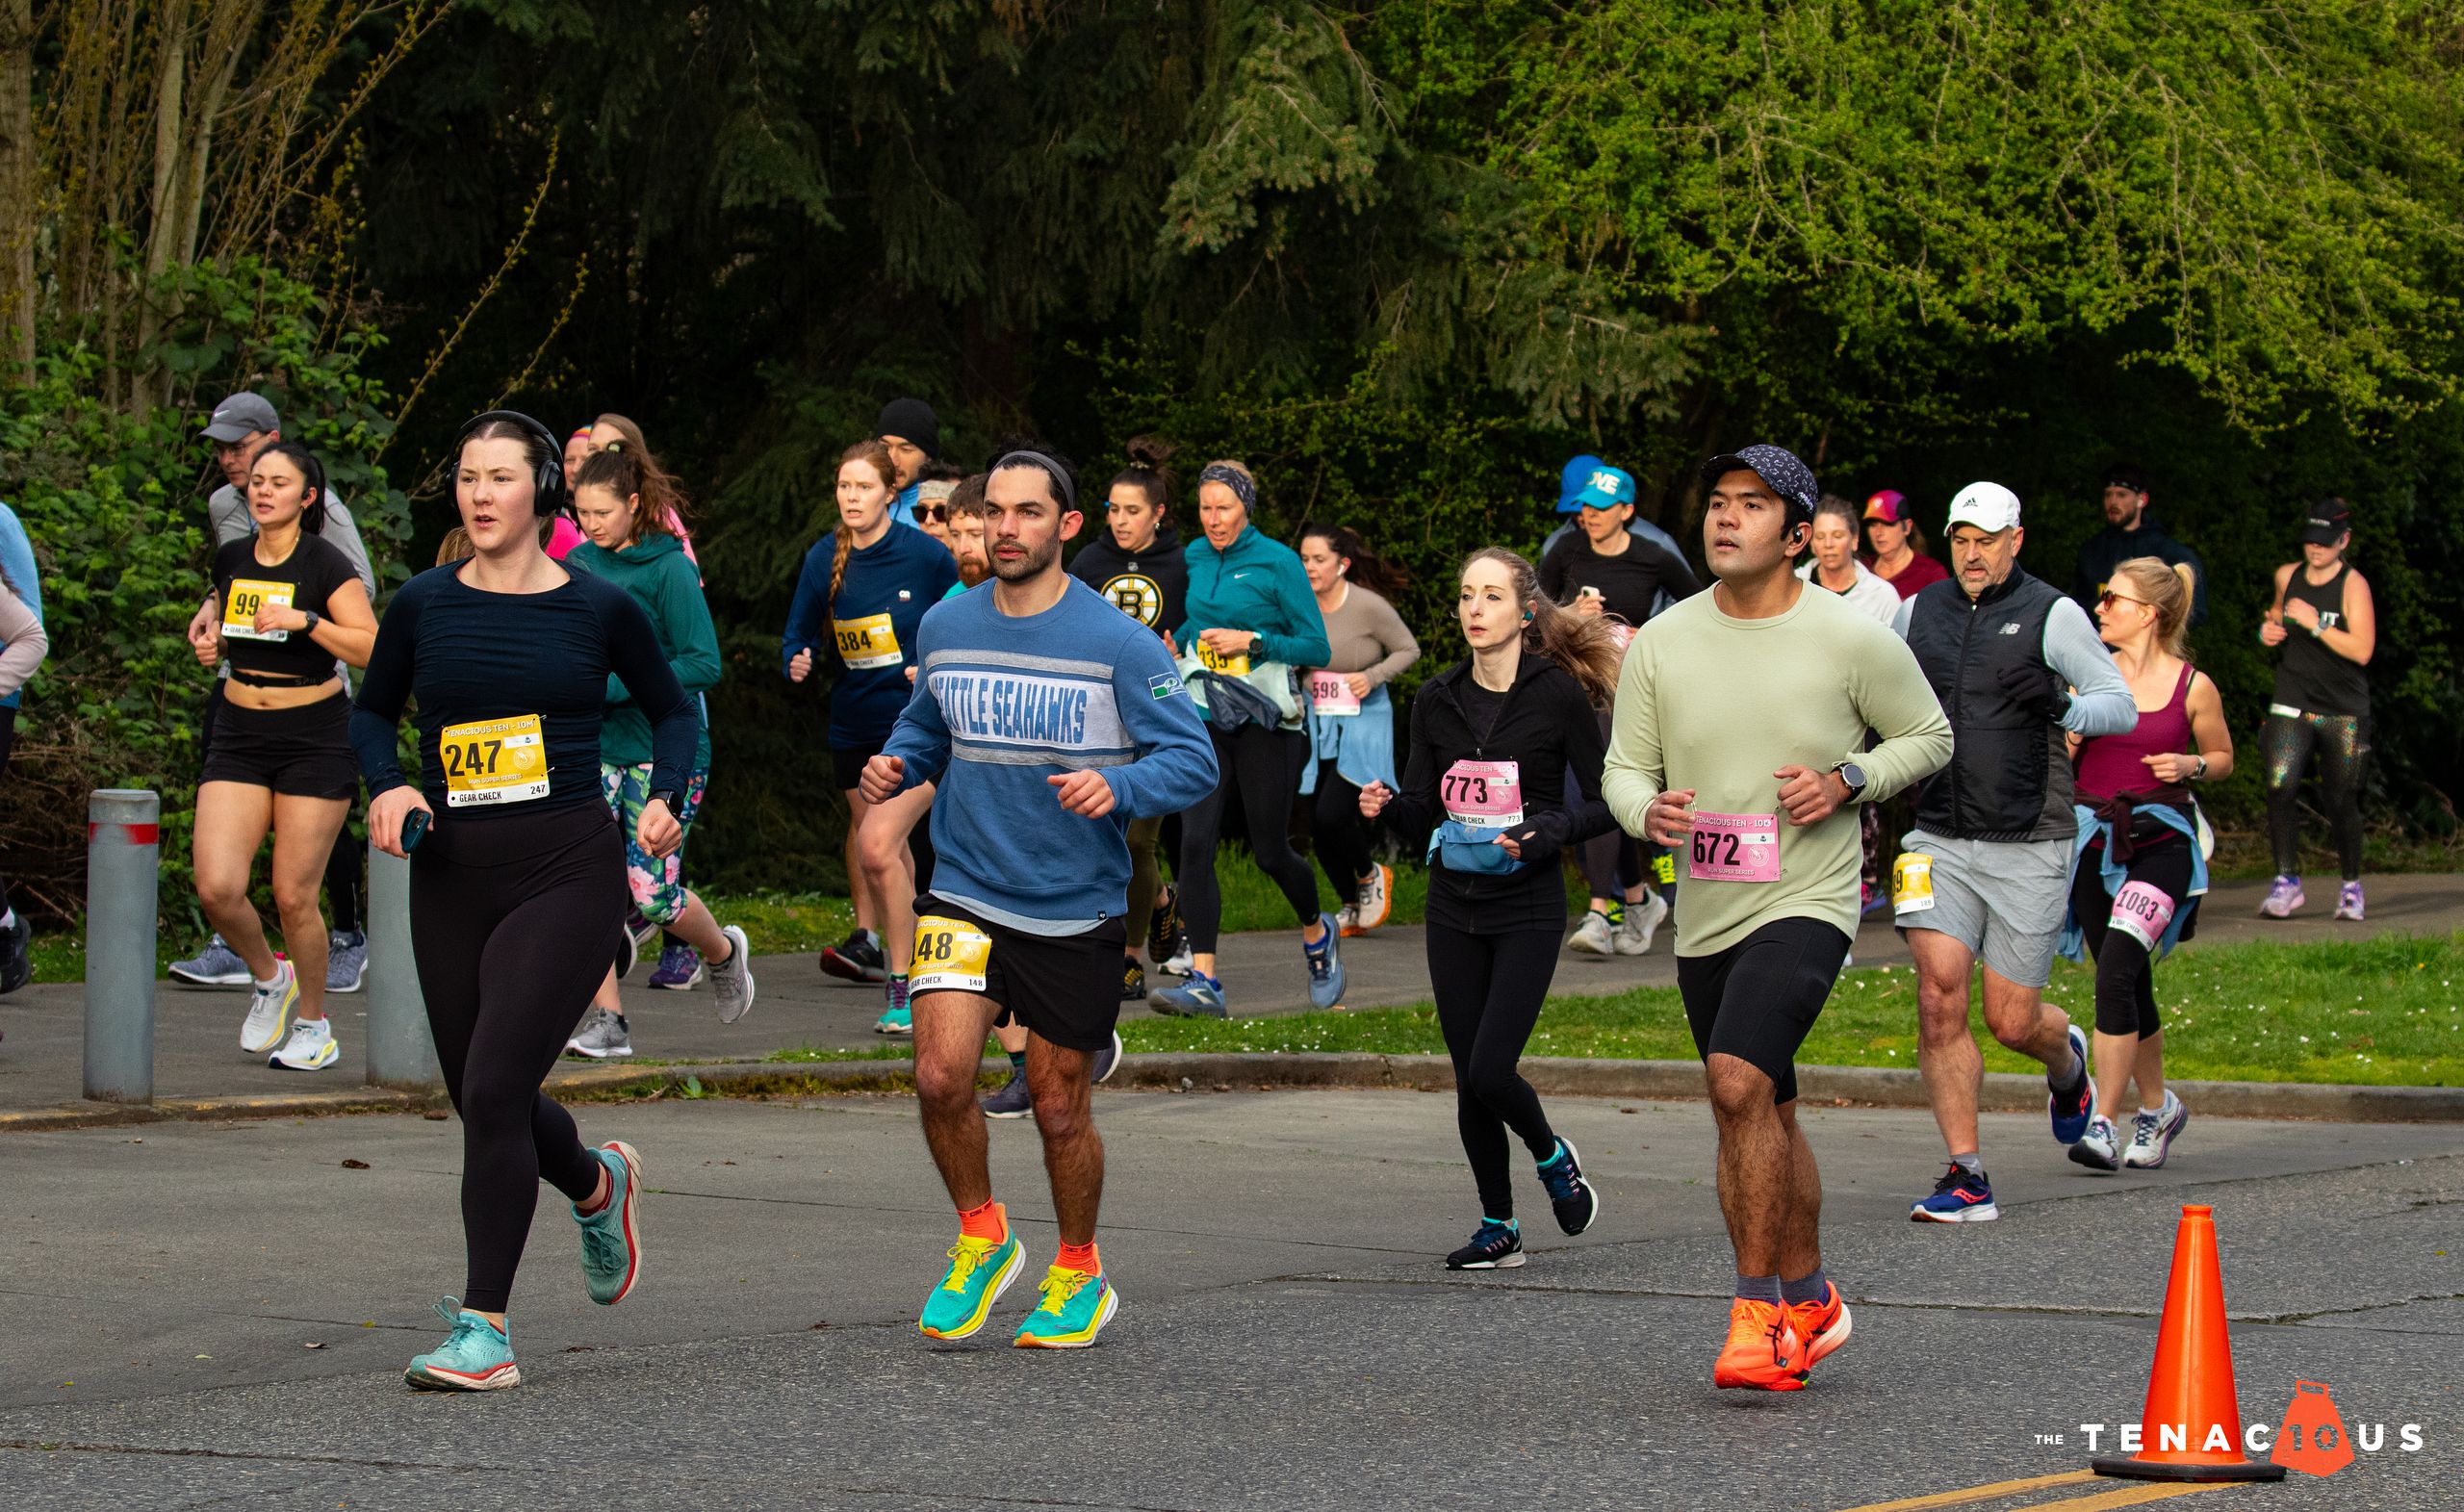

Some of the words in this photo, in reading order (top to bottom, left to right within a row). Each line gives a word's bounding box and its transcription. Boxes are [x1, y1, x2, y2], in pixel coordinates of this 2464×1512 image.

[235, 593, 260, 616] 99
[838, 630, 872, 652] 384
[1312, 681, 1339, 700] 598
[991, 679, 1088, 744] SEAHAWKS
[448, 726, 492, 737] TENACIOUS
[493, 724, 509, 732] TEN
[445, 740, 501, 778] 247
[459, 793, 478, 803] GEAR
[479, 791, 502, 801] CHECK
[530, 784, 546, 795] 247
[1446, 775, 1488, 804] 773
[1467, 816, 1485, 825] CHECK
[1696, 816, 1732, 827] TENACIOUS
[1694, 831, 1741, 866] 672
[2117, 890, 2159, 922] 1083
[921, 976, 942, 986] CHECK
